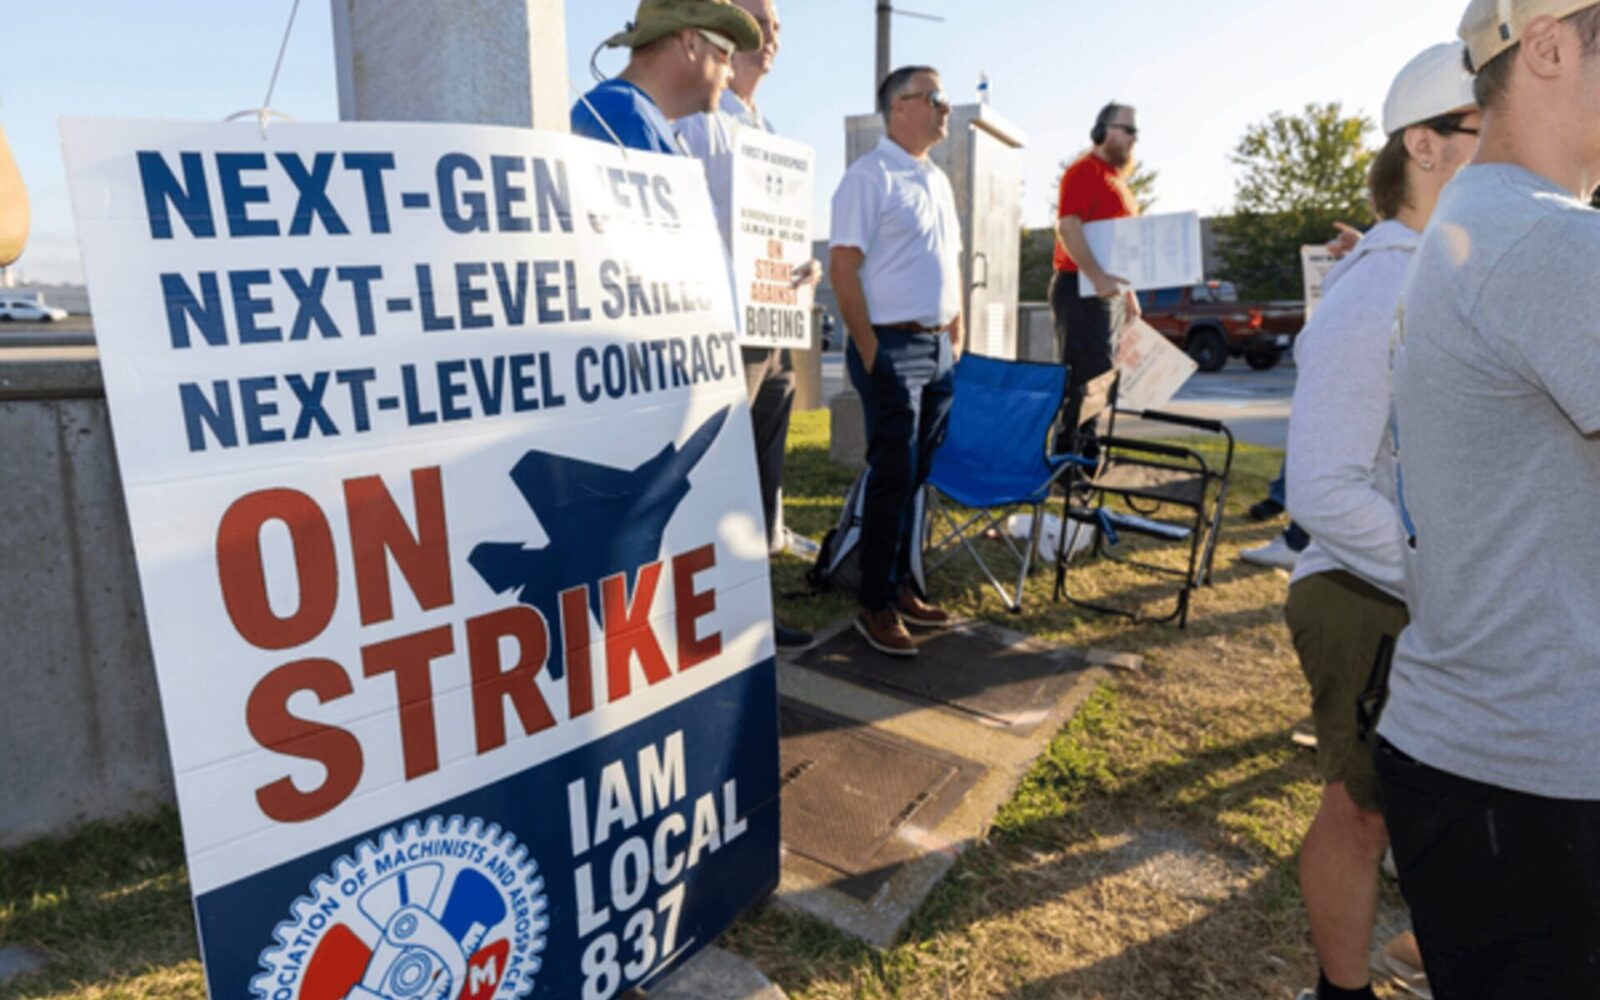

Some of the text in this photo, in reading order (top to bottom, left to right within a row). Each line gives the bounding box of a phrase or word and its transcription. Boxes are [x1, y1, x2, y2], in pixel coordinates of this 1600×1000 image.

[136, 150, 574, 240] NEXT-GEN
[160, 259, 592, 348] NEXT-LEVEL
[745, 305, 804, 339] BOEING
[179, 332, 737, 452] NEXT-LEVEL CONTRACT
[216, 465, 454, 650] ON
[246, 542, 722, 823] STRIKE
[567, 730, 687, 856] IAM
[341, 868, 368, 896] OF
[374, 838, 489, 875] MACHINISTS
[486, 855, 516, 887] AND
[501, 887, 531, 991] AEROSPACE
[574, 779, 747, 938] LOCAL
[580, 881, 686, 1000] 837
